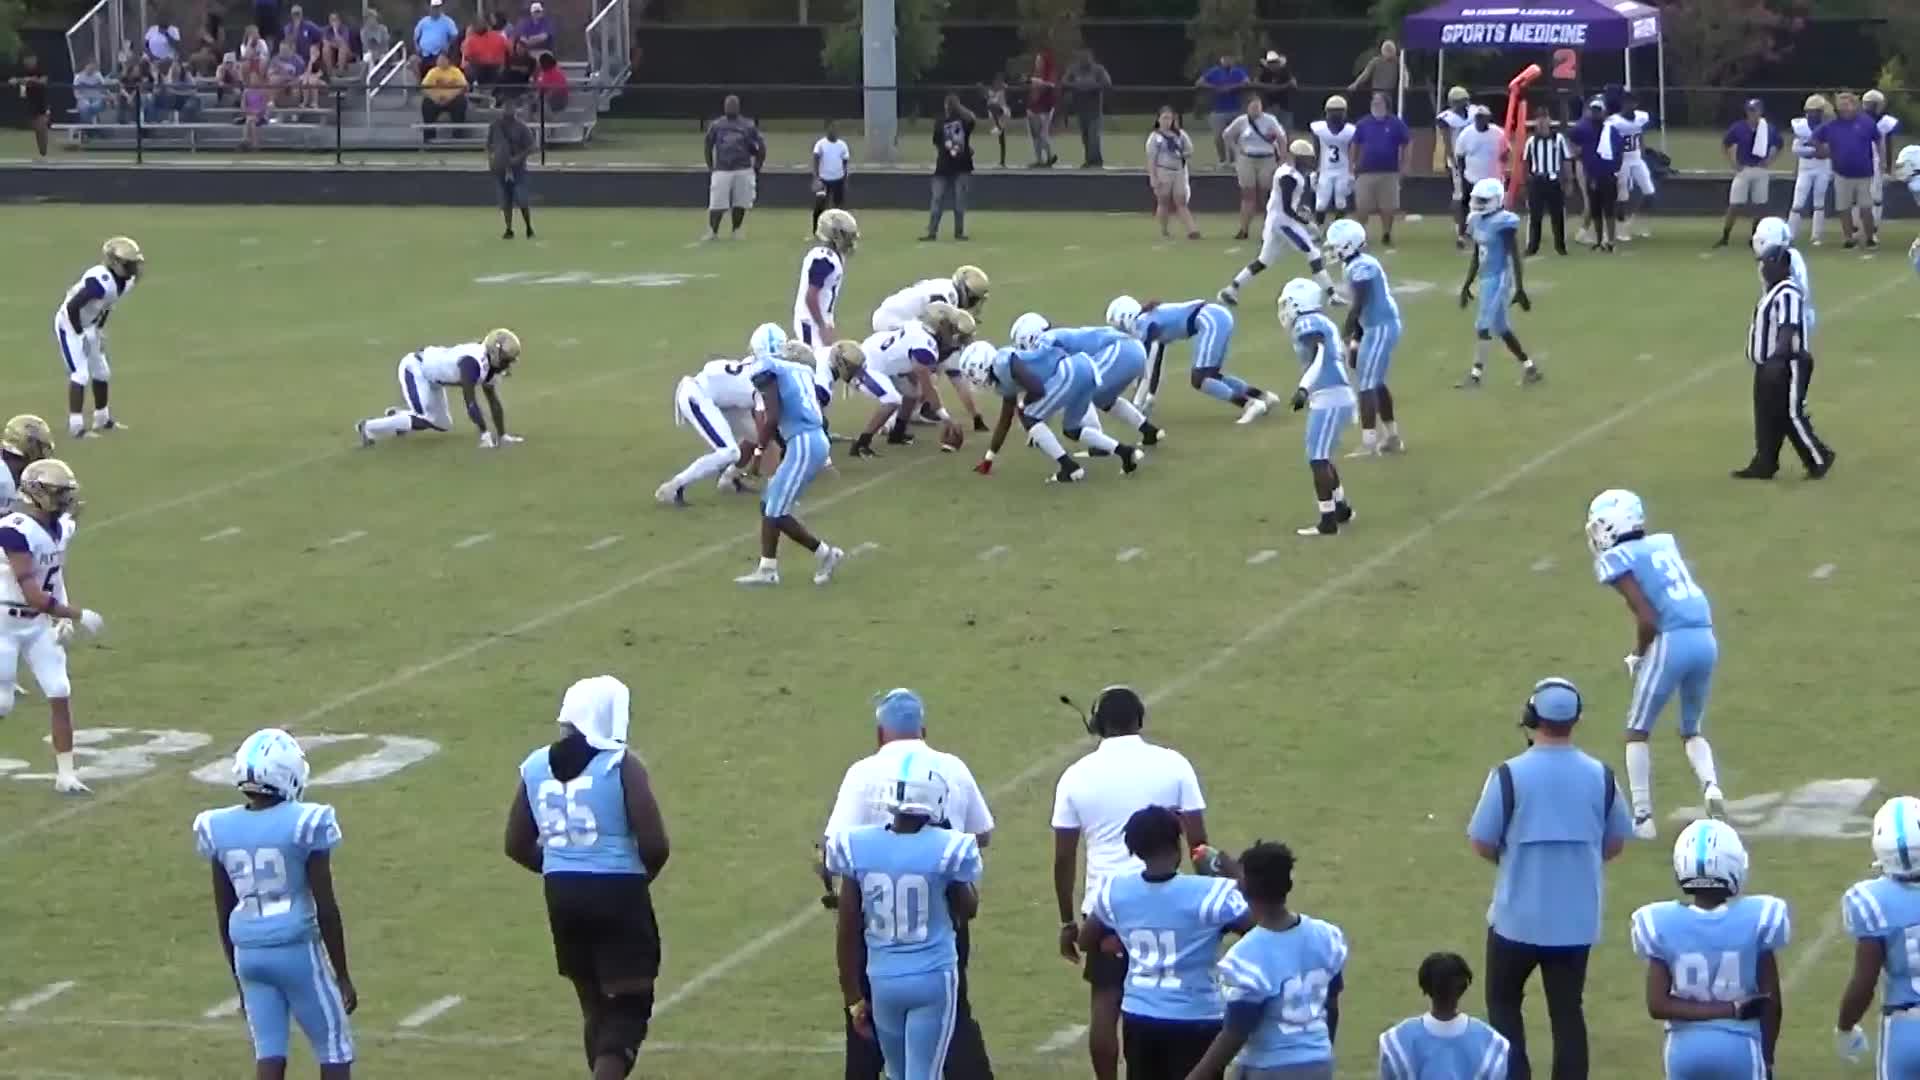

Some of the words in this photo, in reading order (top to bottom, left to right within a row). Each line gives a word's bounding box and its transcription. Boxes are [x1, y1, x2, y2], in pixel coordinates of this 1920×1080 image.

[1441, 23, 1506, 43] SPORTS
[1509, 22, 1587, 43] MEDICINE
[1552, 48, 1577, 80] 2
[1328, 144, 1340, 163] 3
[863, 871, 929, 944] 30
